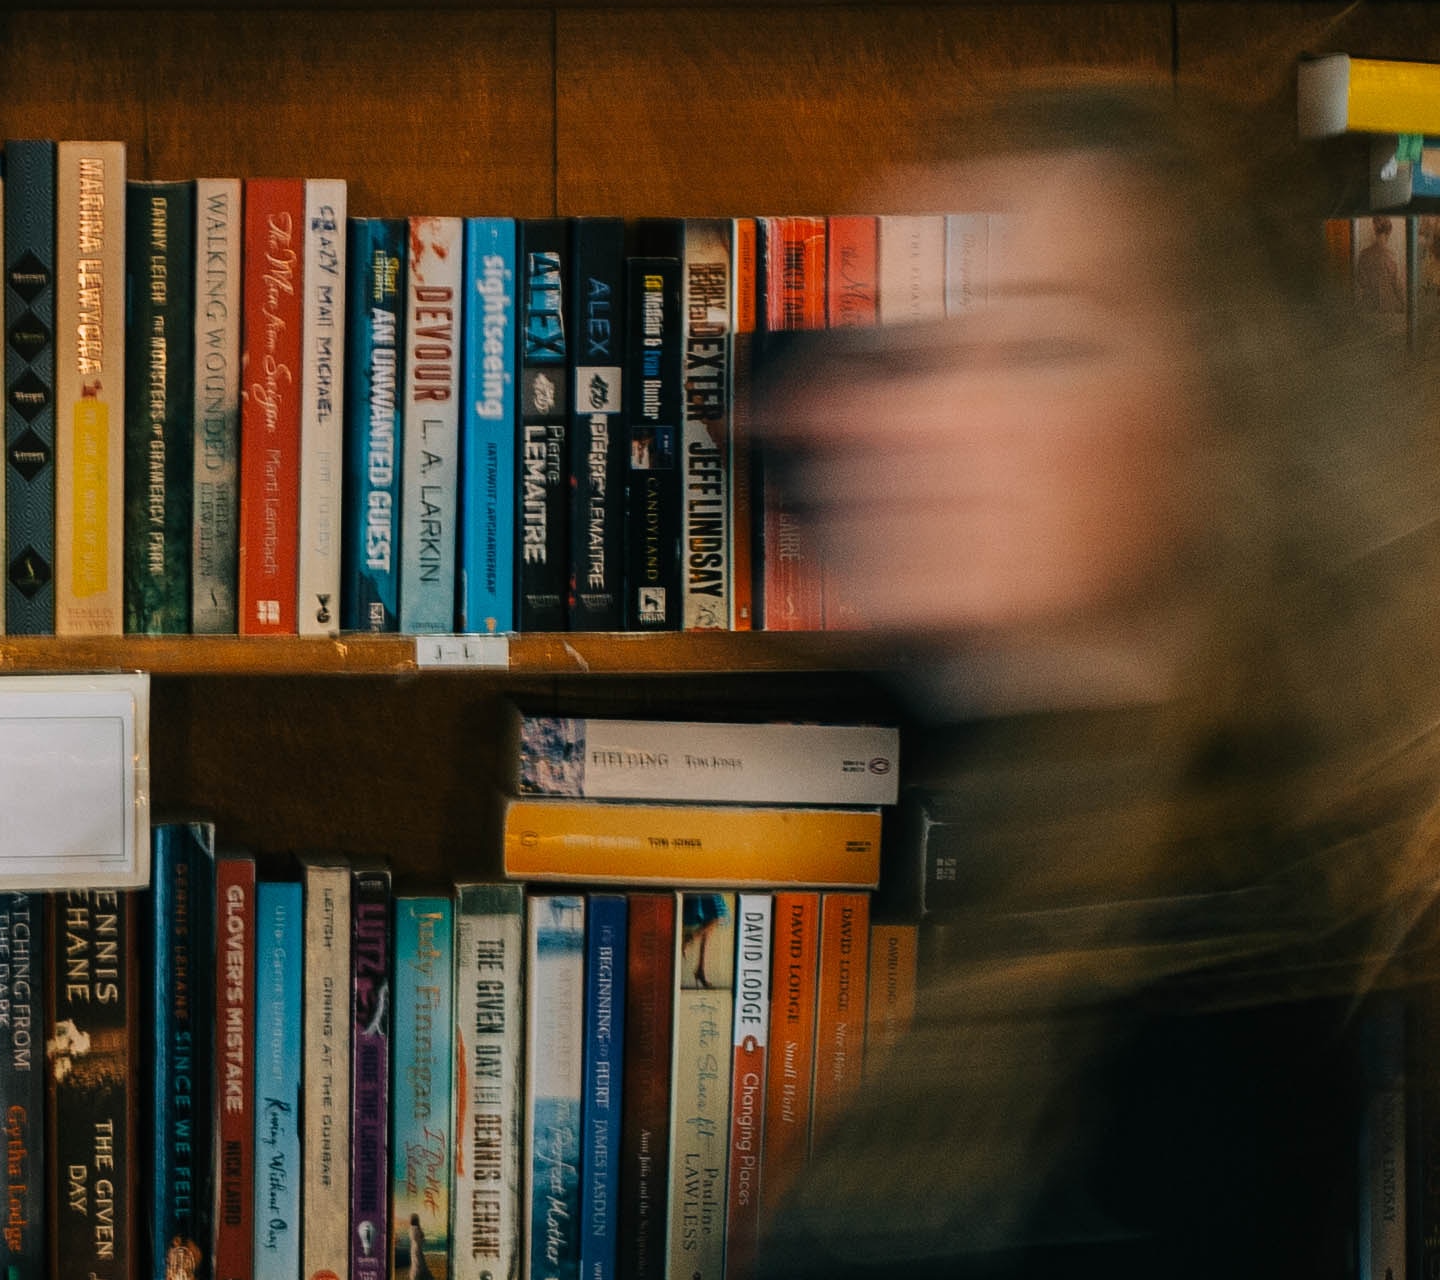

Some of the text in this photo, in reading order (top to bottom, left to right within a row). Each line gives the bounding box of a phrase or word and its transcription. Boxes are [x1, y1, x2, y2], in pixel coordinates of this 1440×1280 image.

[412, 285, 453, 402] DEVOUR
[476, 255, 507, 418] sightseeing
[523, 425, 546, 564] LEMAITRE
[226, 885, 244, 1113] GLOVER'S MISTAKE
[472, 1114, 503, 1259] DENNIS LEHANE
